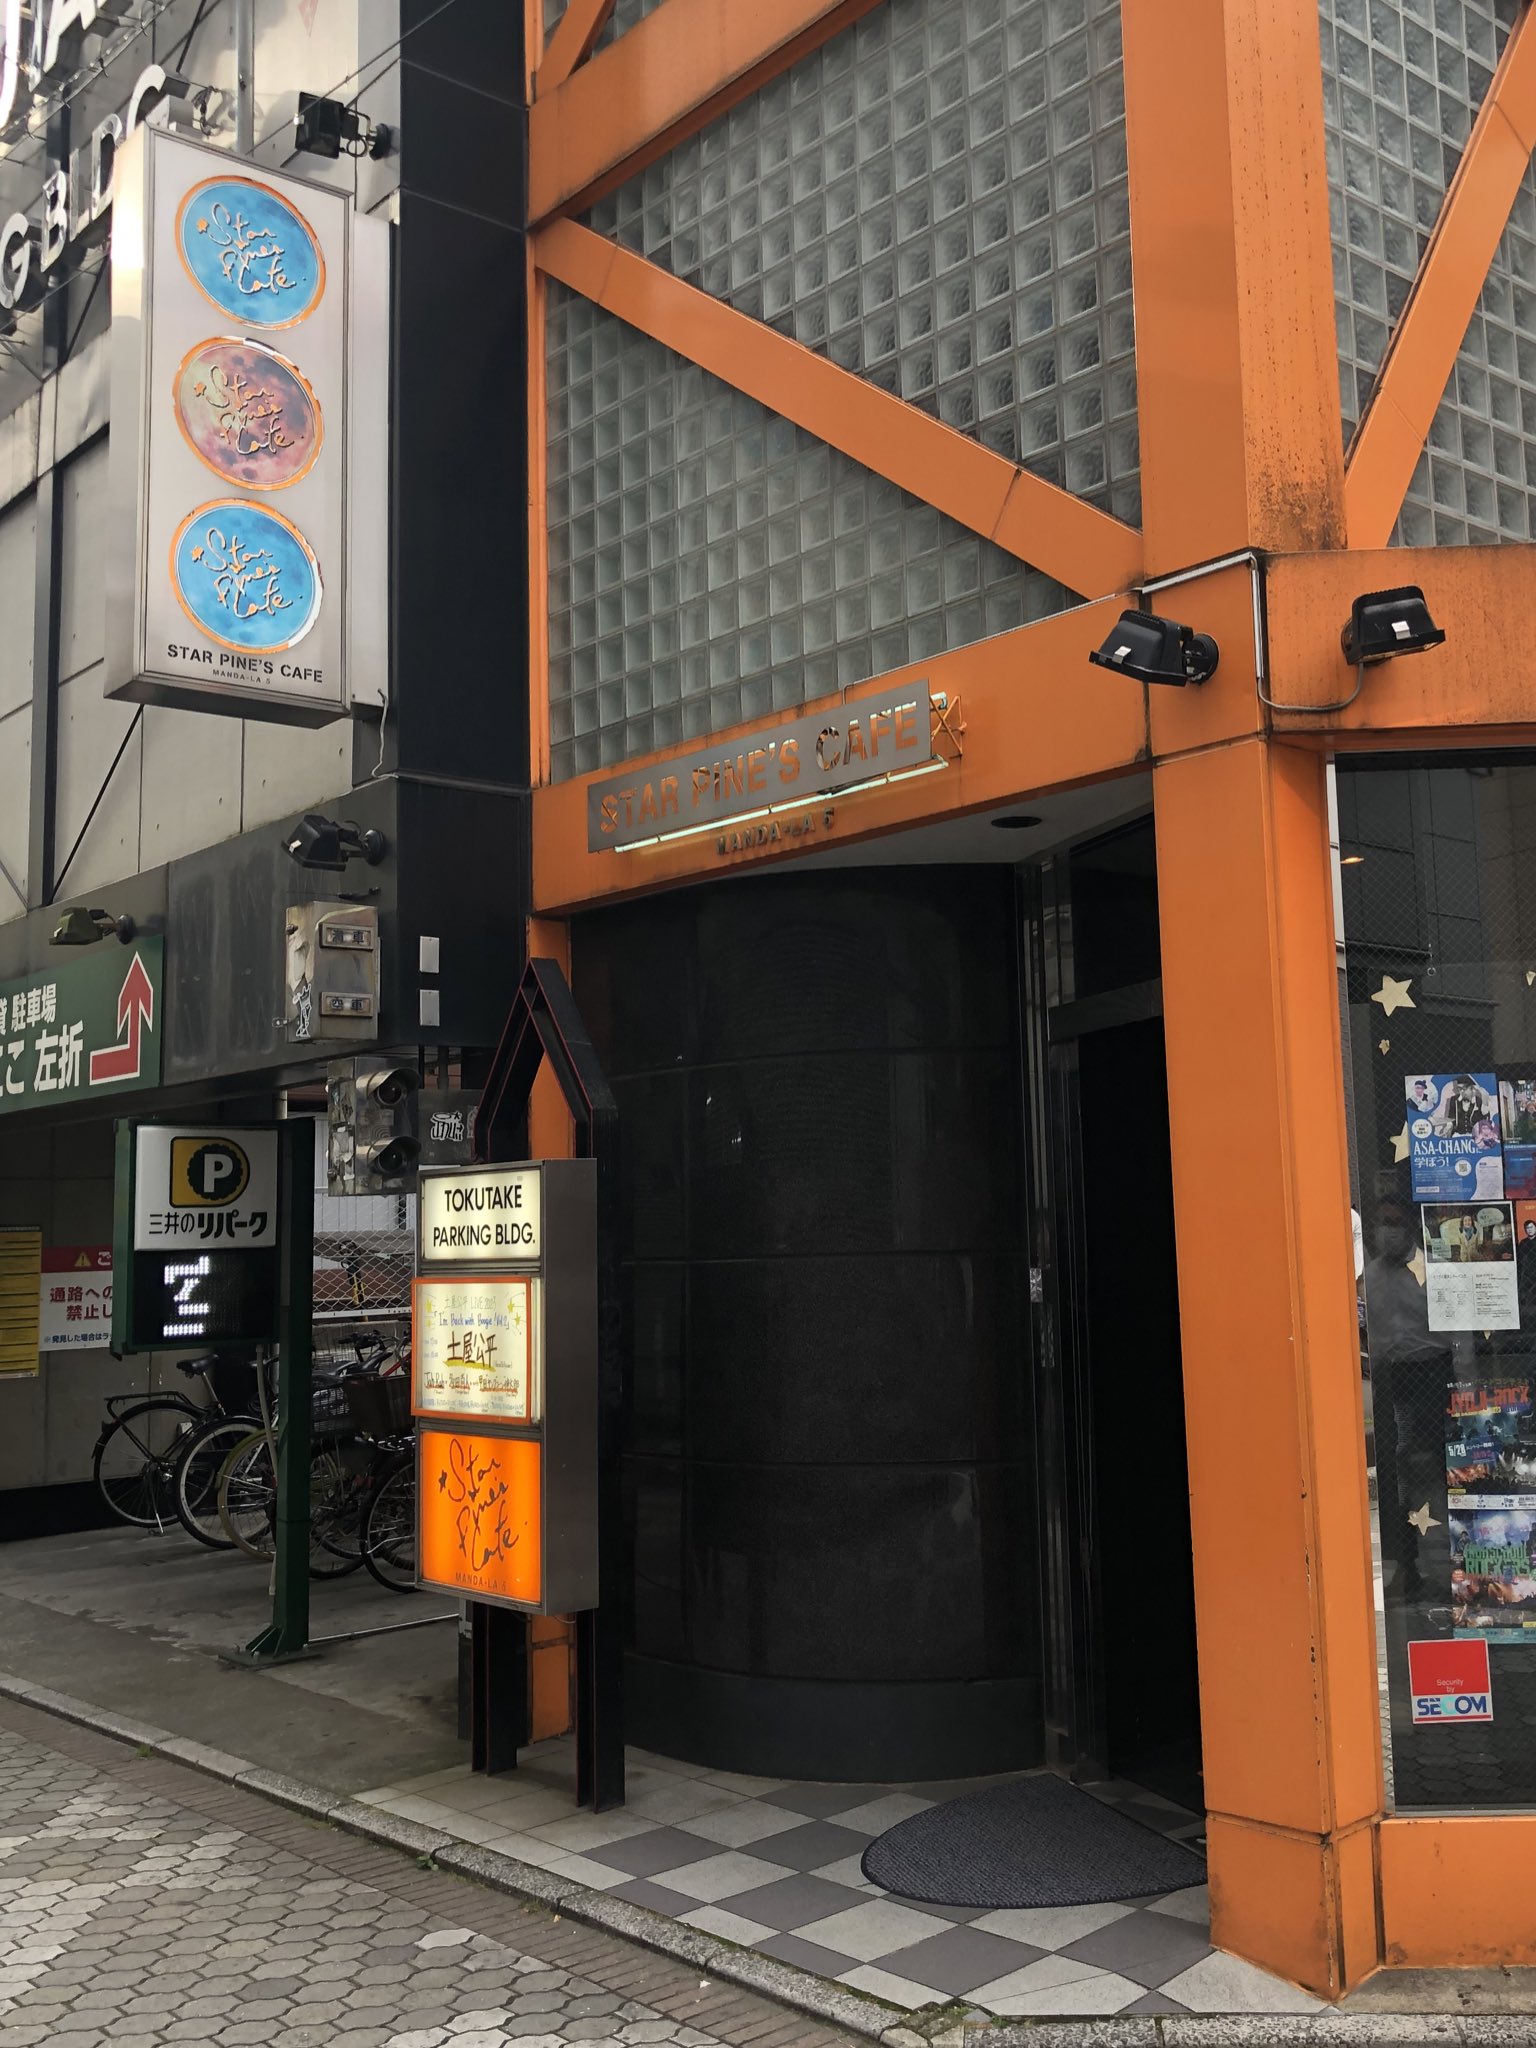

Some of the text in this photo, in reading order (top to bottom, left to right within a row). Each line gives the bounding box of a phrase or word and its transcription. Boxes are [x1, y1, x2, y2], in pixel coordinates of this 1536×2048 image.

[208, 202, 277, 246] Star
[206, 365, 275, 409] Star
[202, 528, 274, 572] Star
[167, 643, 323, 683] STAR PINE'S CAFE
[212, 668, 262, 684] MANDA-LA
[600, 701, 919, 833] STAR PINE'S CAFE
[0, 1020, 83, 1096] こ 左折
[444, 1184, 523, 1212] TOKUTAKE
[149, 1209, 268, 1239] 三井のリパーク
[433, 1222, 536, 1248] PARKING BLDG.
[447, 1438, 501, 1503] Star
[455, 1572, 498, 1588] MANDA-LA
[1436, 1678, 1464, 1687] Security
[1417, 1695, 1487, 1715] SECOM
